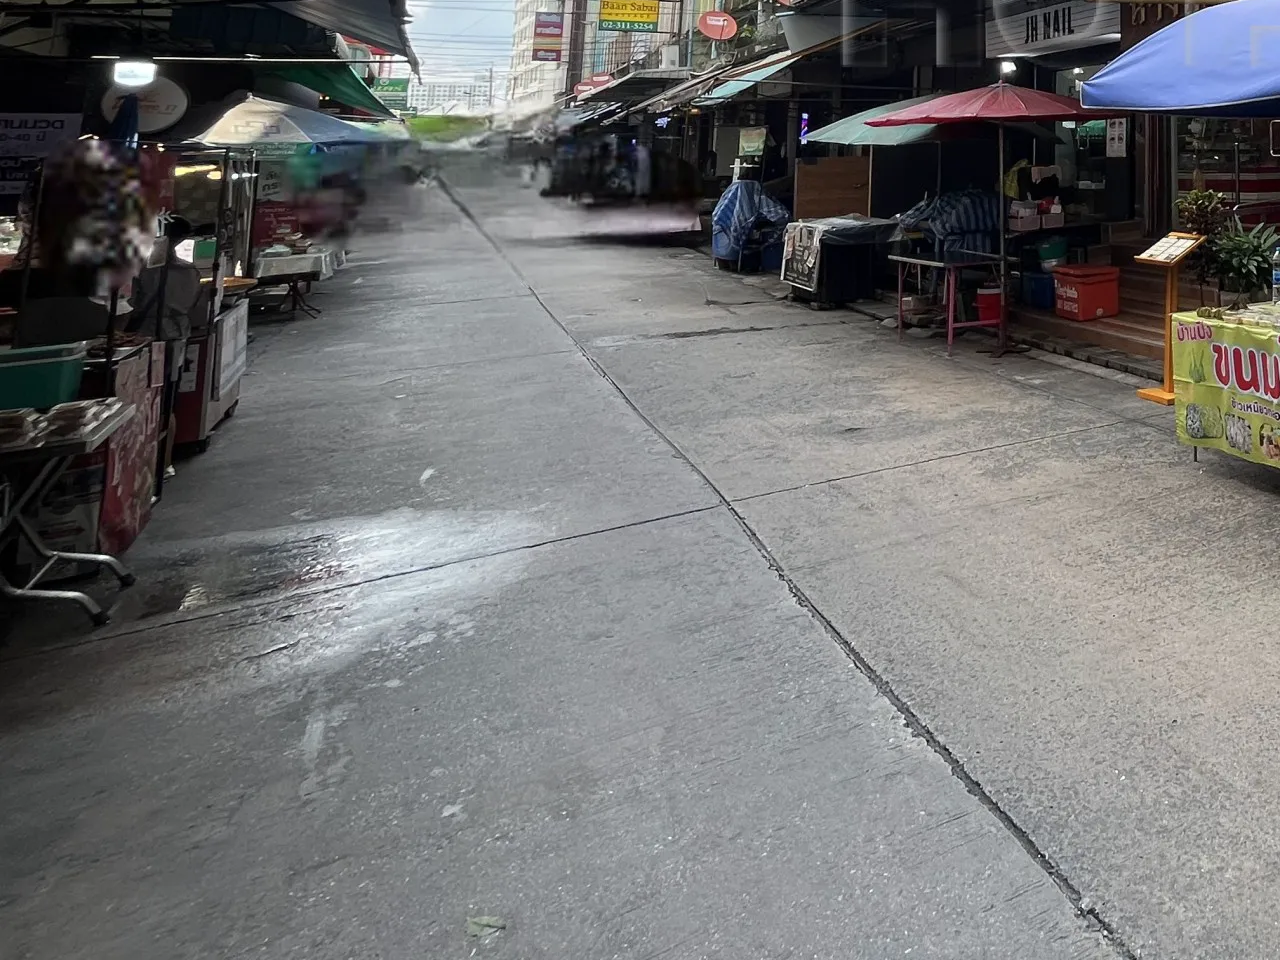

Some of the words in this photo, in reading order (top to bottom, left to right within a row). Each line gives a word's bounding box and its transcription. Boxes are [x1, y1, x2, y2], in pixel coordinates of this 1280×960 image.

[602, 0, 628, 12] Baan
[1025, 14, 1039, 44] JH
[1043, 6, 1075, 40] NAIL
